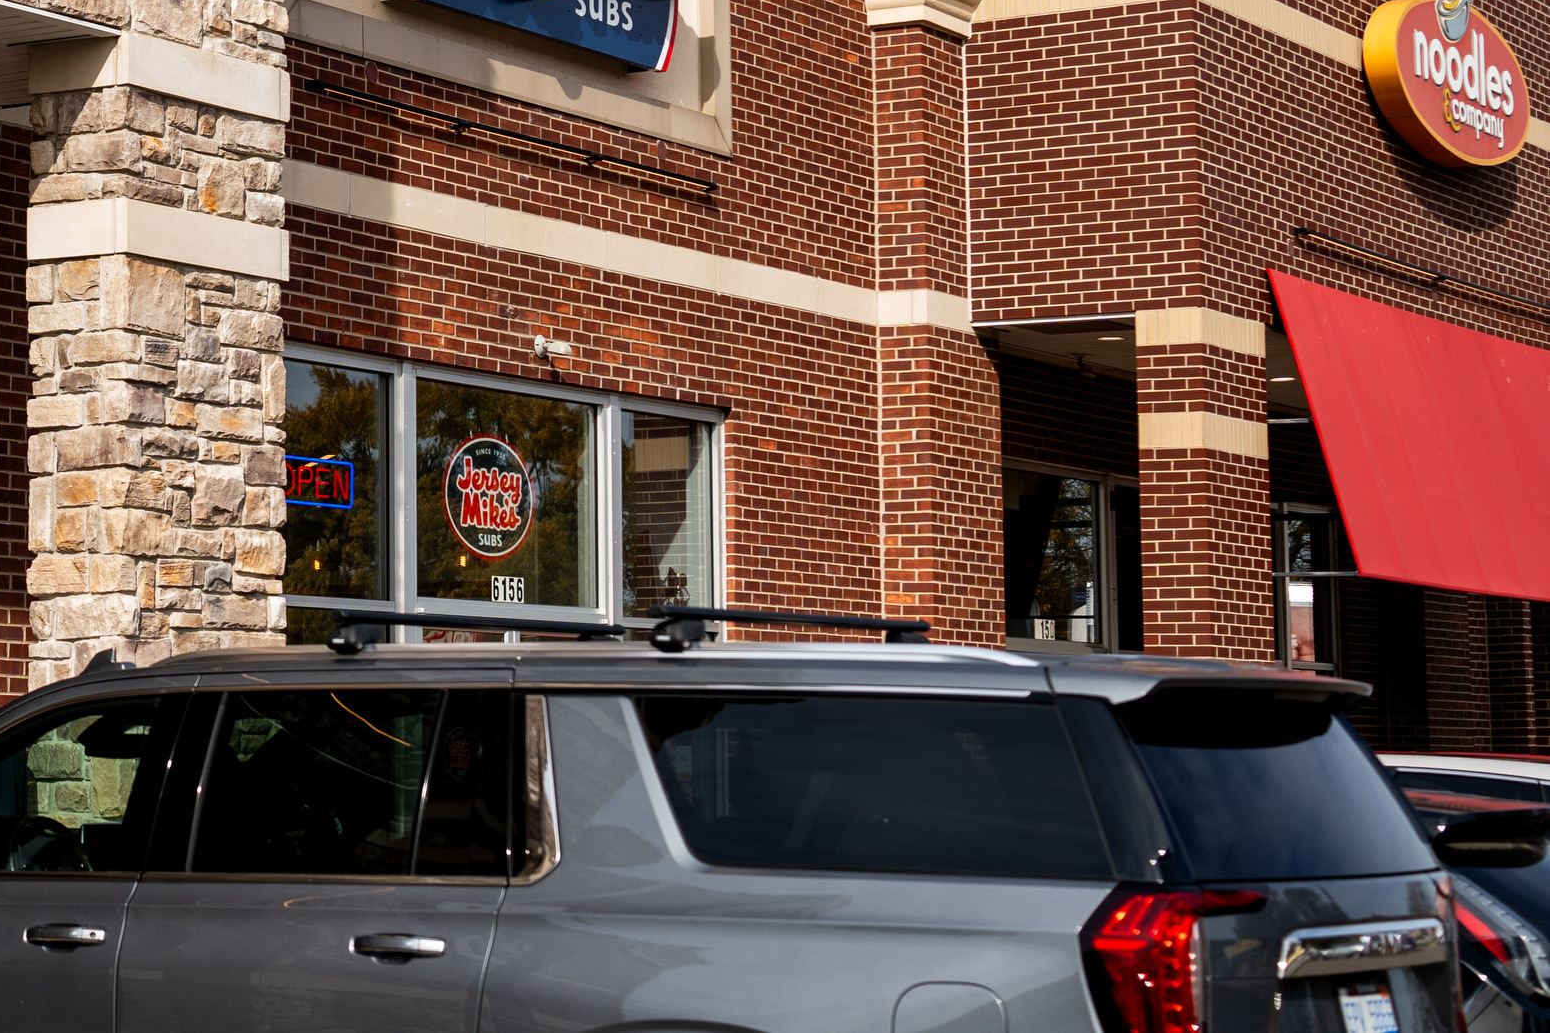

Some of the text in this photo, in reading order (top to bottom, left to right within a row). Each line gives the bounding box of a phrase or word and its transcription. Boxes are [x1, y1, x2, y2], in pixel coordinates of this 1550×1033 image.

[1413, 28, 1514, 116] noodles
[1452, 98, 1505, 149] company
[475, 448, 491, 456] SINCE
[456, 456, 521, 505] Jersey
[460, 491, 521, 530] Mike's
[478, 533, 502, 547] SUBS
[492, 576, 524, 603] 6156
